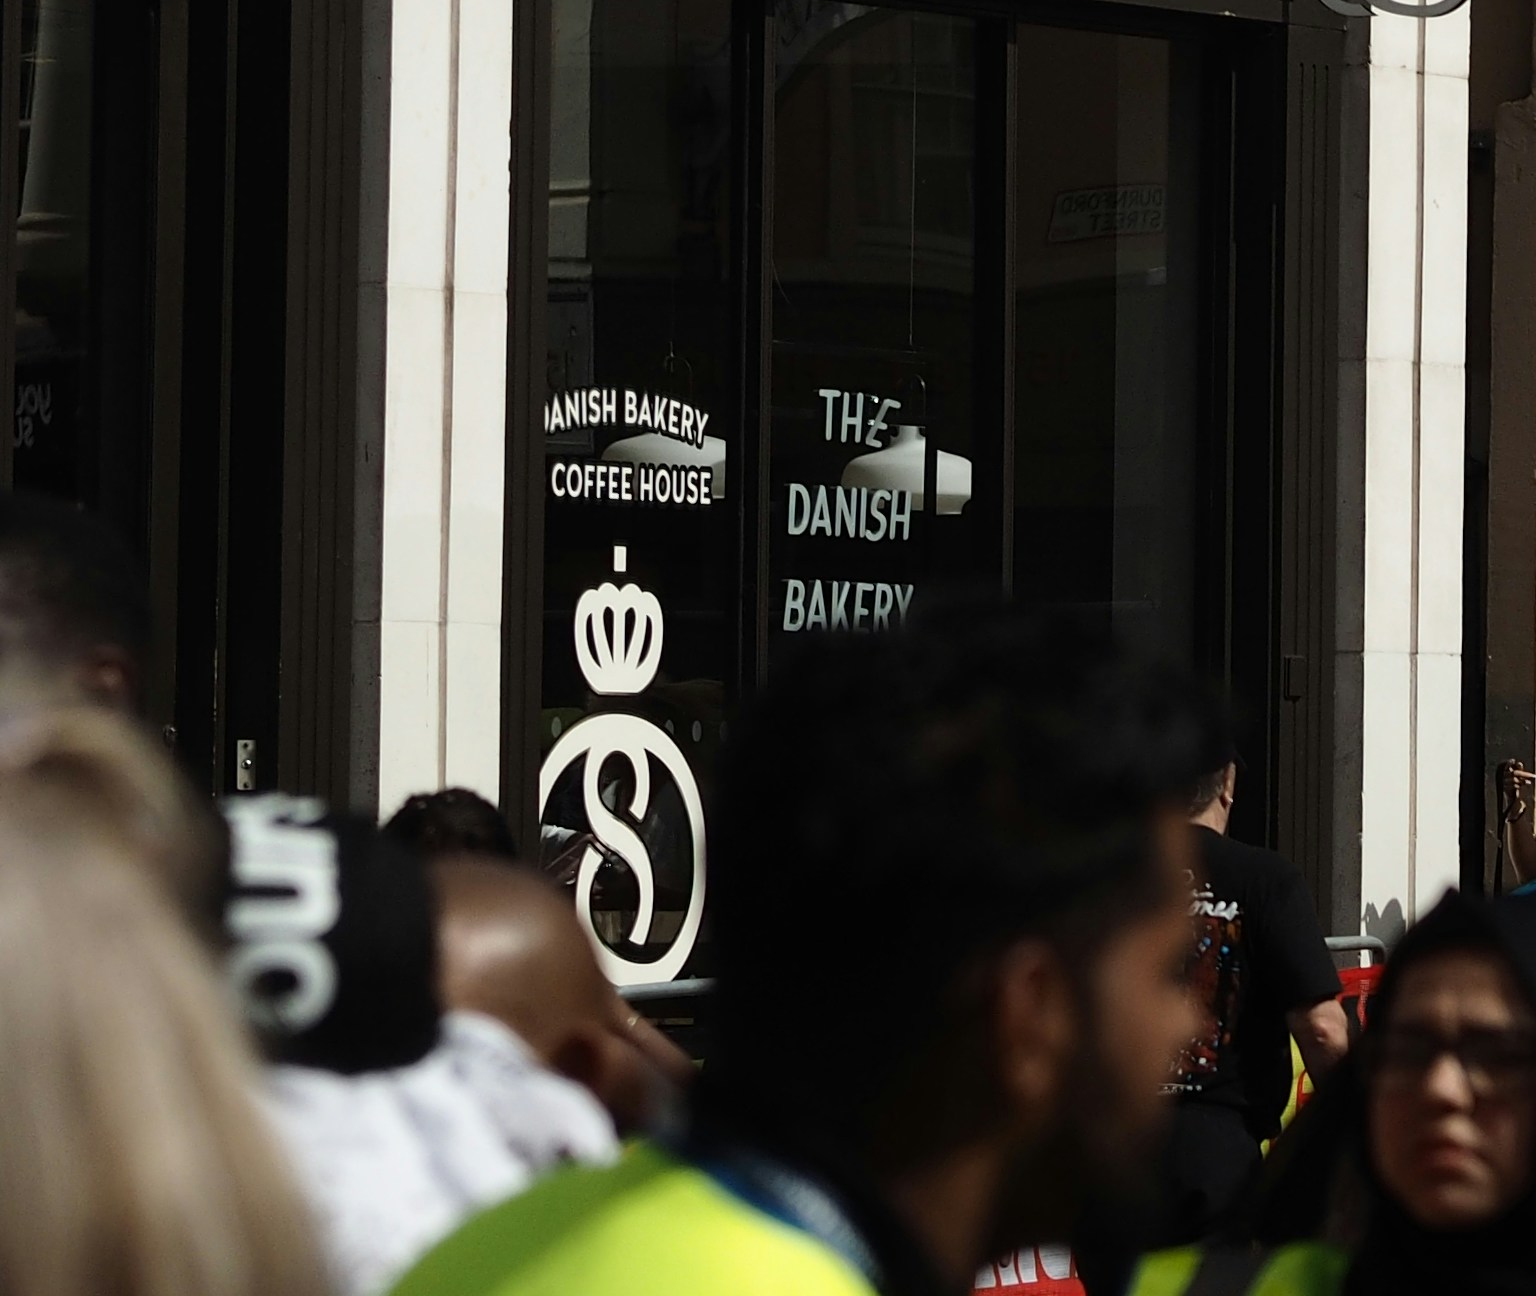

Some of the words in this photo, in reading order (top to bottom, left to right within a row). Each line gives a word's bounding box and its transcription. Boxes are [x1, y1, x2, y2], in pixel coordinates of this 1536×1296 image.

[624, 390, 709, 445] BAKERY
[818, 388, 902, 448] THE
[551, 462, 632, 502] COFFEE
[640, 465, 712, 505] HOUSE
[787, 482, 913, 542] DANISH
[782, 578, 914, 634] BAKERY
